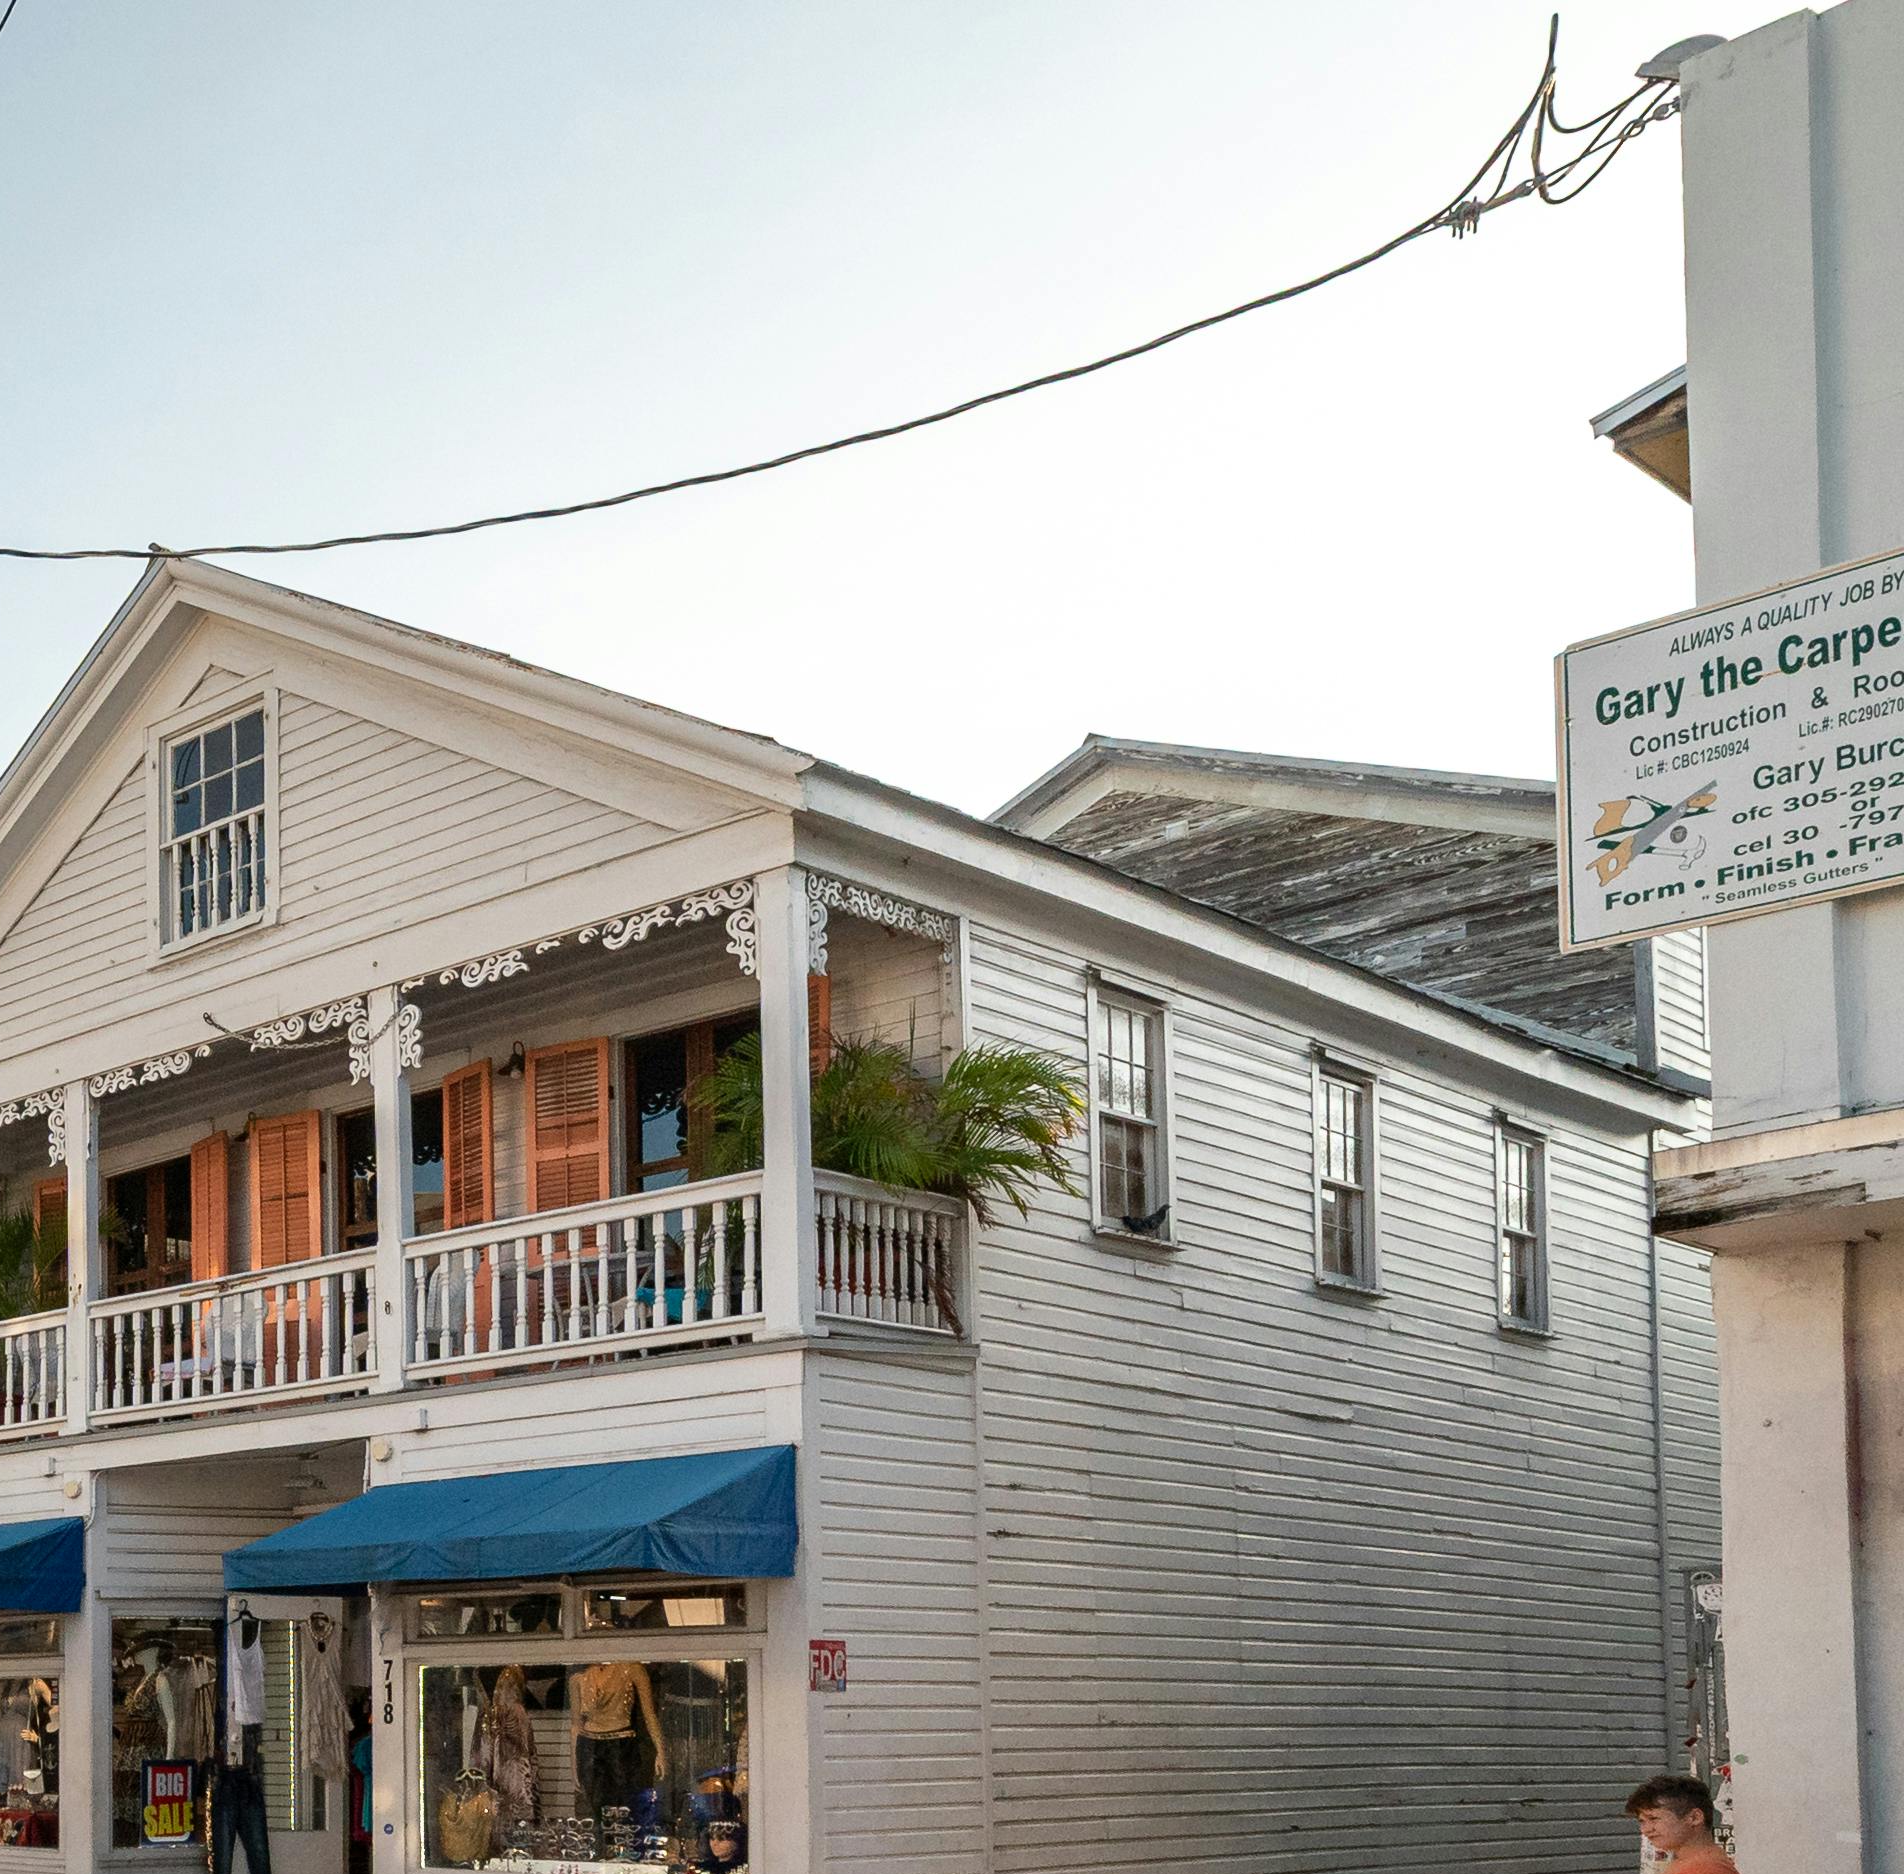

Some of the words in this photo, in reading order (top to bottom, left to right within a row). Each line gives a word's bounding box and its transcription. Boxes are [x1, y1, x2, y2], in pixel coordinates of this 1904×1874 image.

[1669, 622, 1734, 657] ALWAYS
[1741, 617, 1753, 637] A
[1757, 591, 1833, 632] QUALITY
[1839, 580, 1875, 607] JOB
[1881, 571, 1904, 596] BY
[1595, 676, 1686, 726] Gary
[1700, 655, 1763, 698] the
[1777, 616, 1903, 676] Carpe
[1629, 702, 1787, 757] Construction
[1811, 686, 1829, 709] &
[1853, 670, 1904, 698] Roo
[1636, 764, 1654, 780] Lic
[1672, 738, 1750, 771] CBC1250924
[1753, 757, 1826, 789] Gary
[1835, 737, 1904, 771] Burc
[1732, 805, 1773, 824] ofc
[1783, 772, 1904, 812] 305-292
[1850, 796, 1880, 812] or
[1605, 881, 1685, 911] Form
[1717, 850, 1814, 886] Finish
[1849, 832, 1904, 856] Fra
[1733, 835, 1772, 856] cel
[1715, 877, 1797, 904] Seamless
[1803, 862, 1870, 884] Gutters
[383, 1659, 394, 1725] 718
[155, 1772, 184, 1796] BIG
[143, 1802, 194, 1837] SALE
